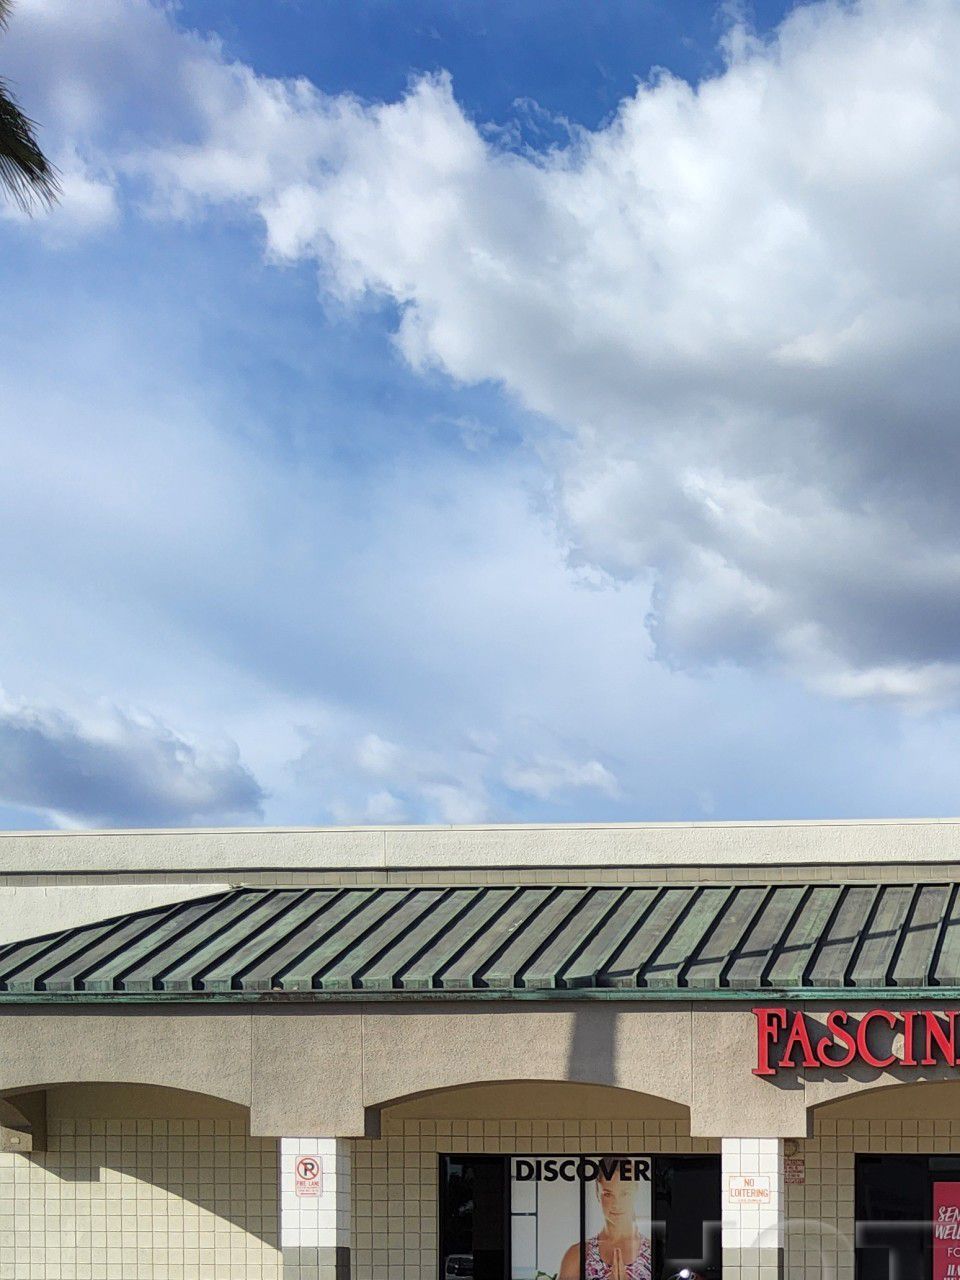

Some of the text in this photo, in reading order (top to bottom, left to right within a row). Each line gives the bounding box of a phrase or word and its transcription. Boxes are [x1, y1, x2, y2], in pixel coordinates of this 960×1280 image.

[515, 1160, 652, 1181] DISCOVER
[743, 1178, 755, 1187] NO
[730, 1188, 769, 1198] LOITERING
